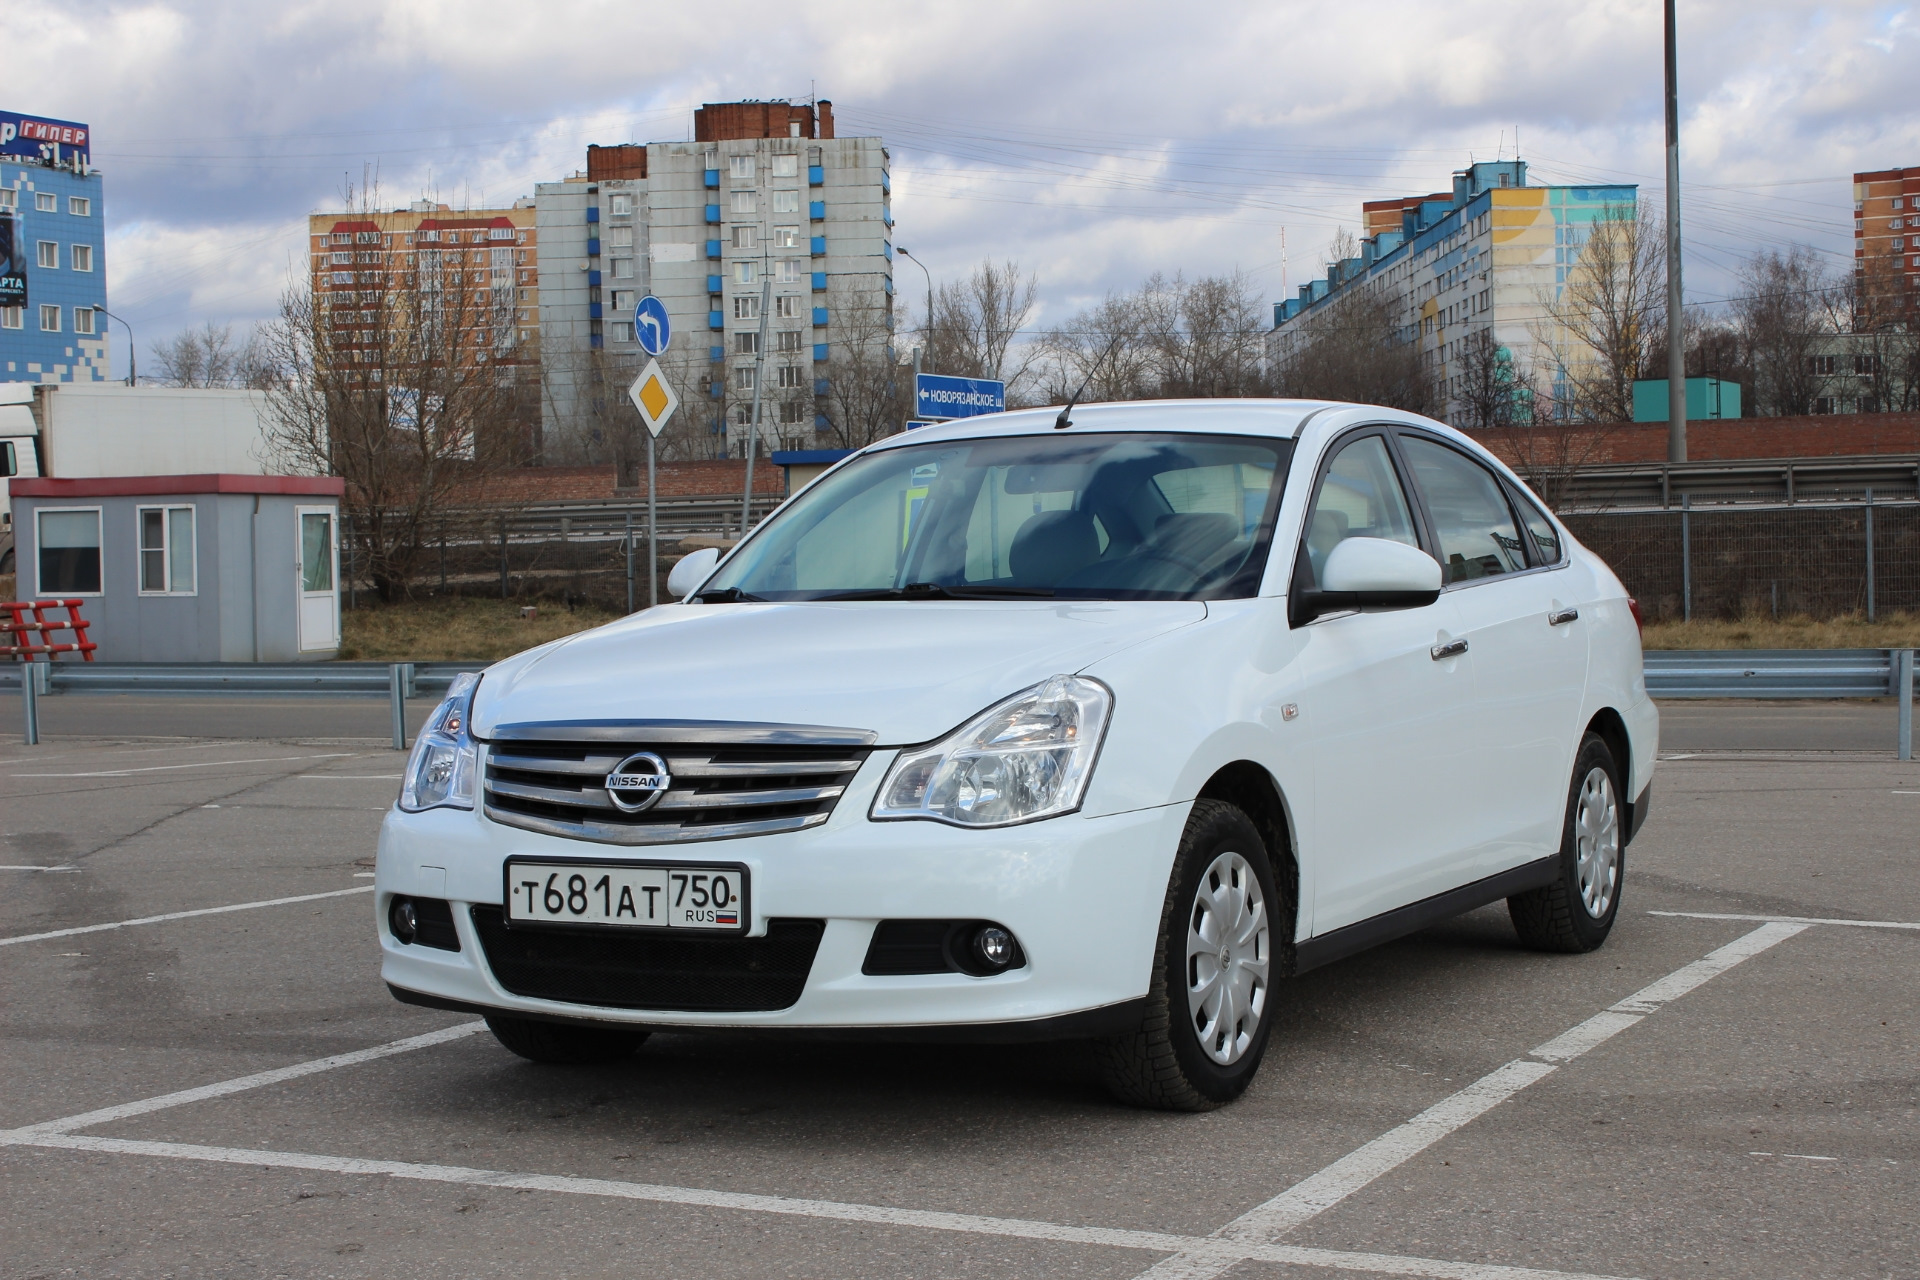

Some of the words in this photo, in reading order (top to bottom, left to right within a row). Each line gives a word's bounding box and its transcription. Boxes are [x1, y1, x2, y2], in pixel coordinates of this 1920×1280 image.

[23, 122, 86, 143] ГИПЕР
[0, 277, 24, 288] РТА
[930, 389, 994, 407] НОВОРЯЗАНСКОЕ
[608, 776, 660, 788] NISSAN
[671, 874, 730, 907] 750
[685, 910, 715, 923] RUS
